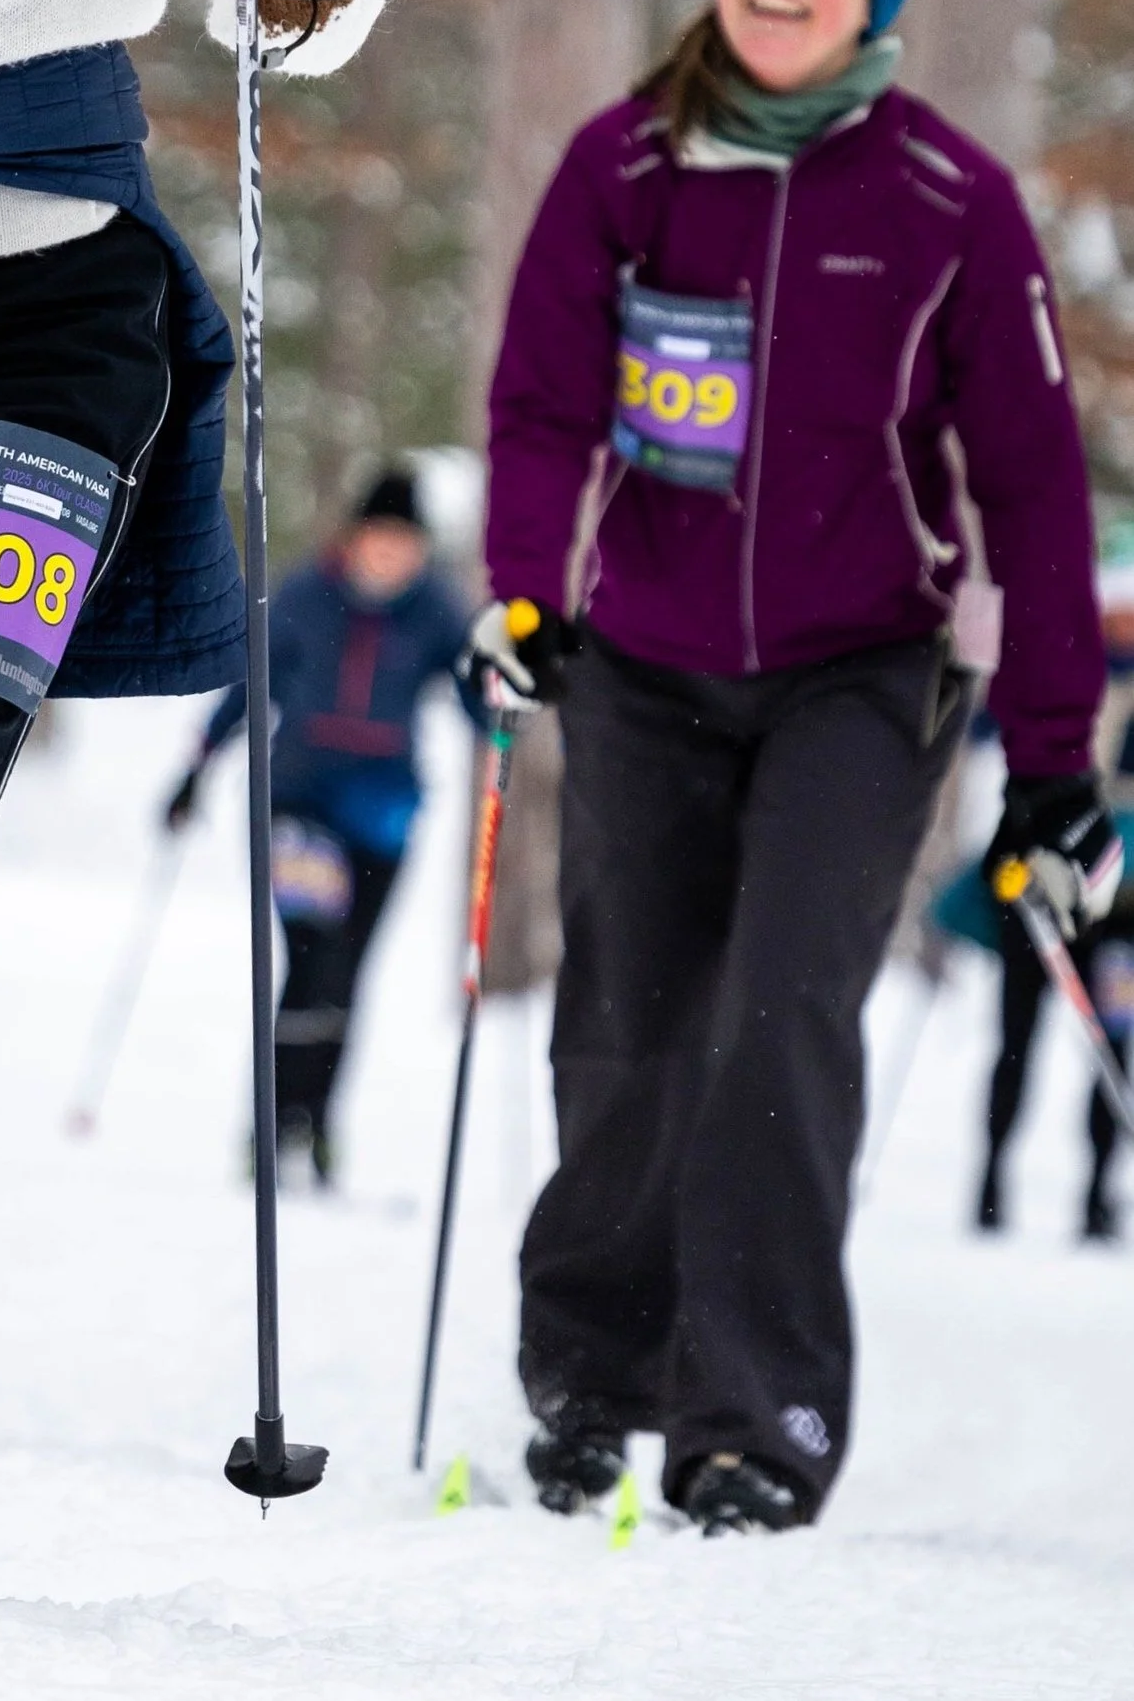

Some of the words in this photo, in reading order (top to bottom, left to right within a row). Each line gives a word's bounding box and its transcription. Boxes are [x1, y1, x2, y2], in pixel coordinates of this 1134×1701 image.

[2, 468, 33, 487] 2025
[36, 478, 52, 493] 6K
[52, 483, 73, 503] Tour
[74, 494, 106, 520] CLASSIC
[16, 452, 84, 485] AMERICAN
[85, 476, 110, 500] VASA
